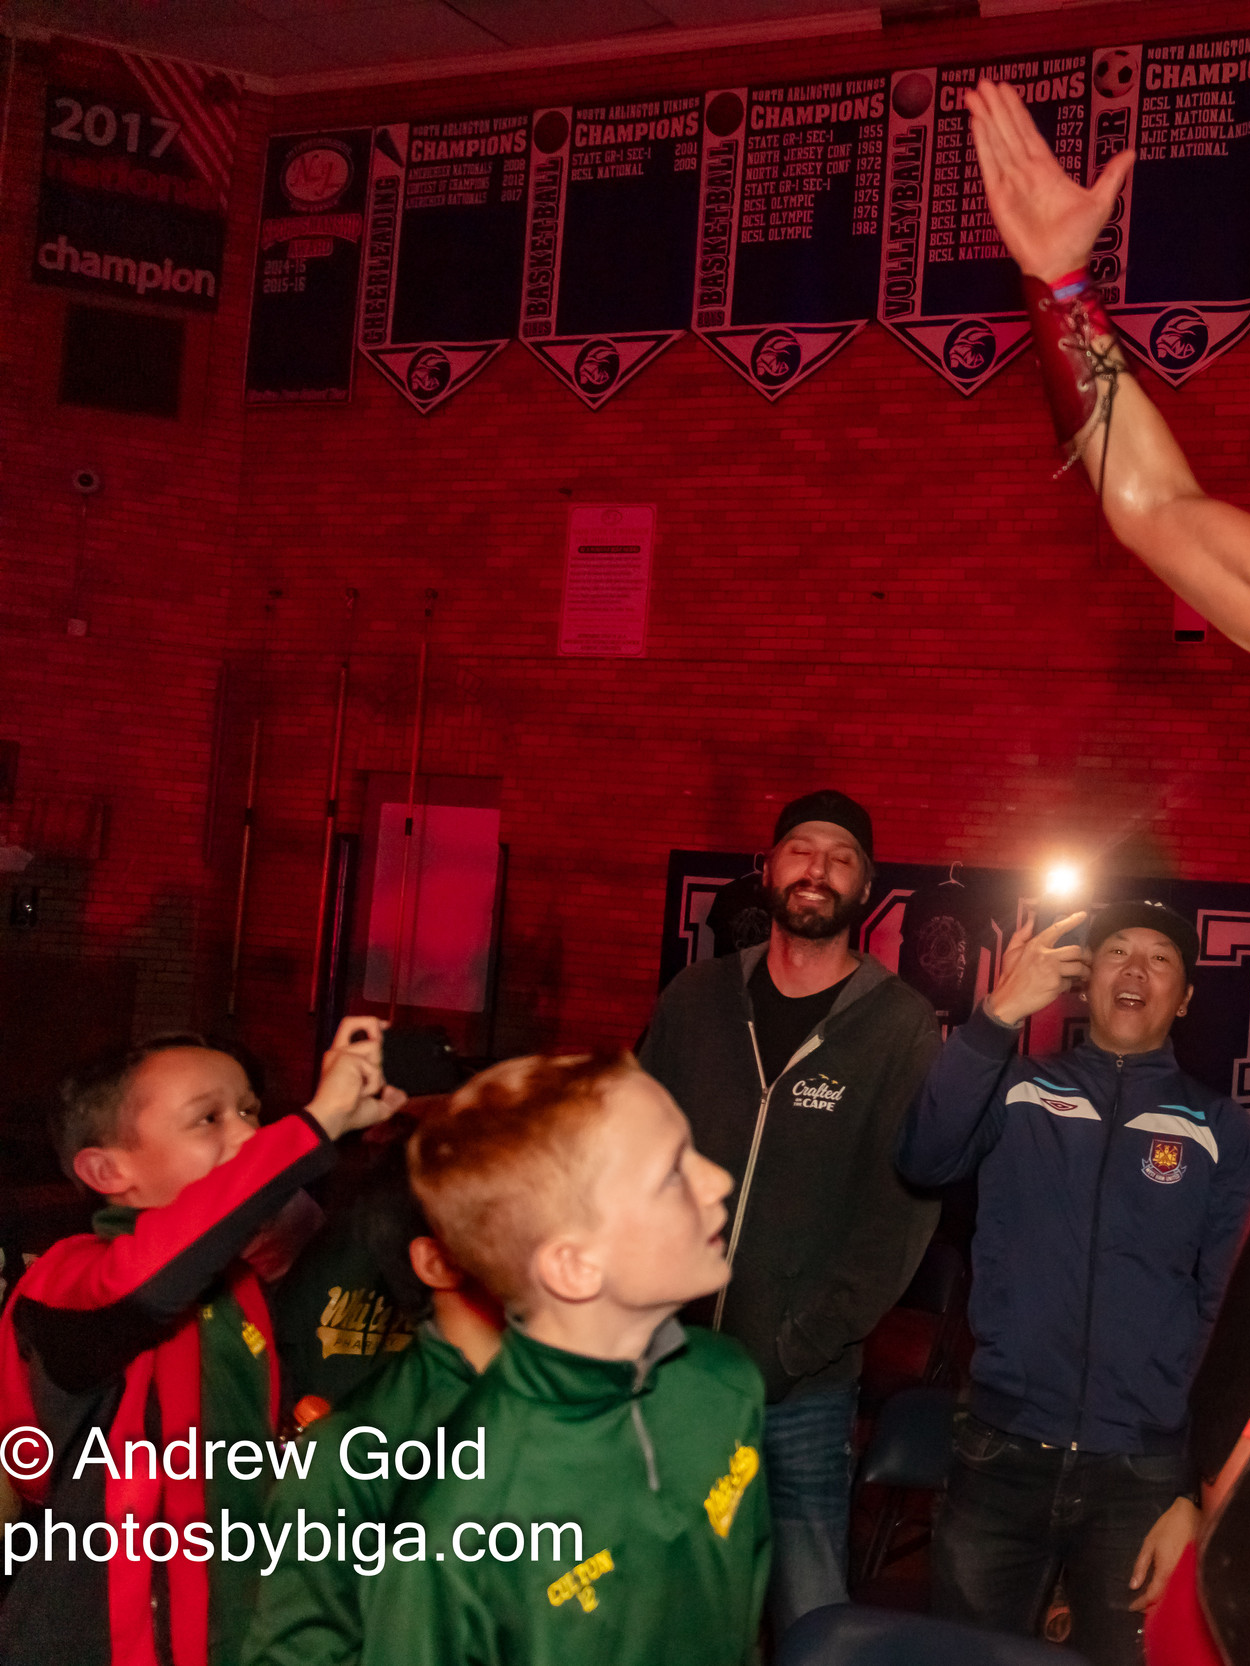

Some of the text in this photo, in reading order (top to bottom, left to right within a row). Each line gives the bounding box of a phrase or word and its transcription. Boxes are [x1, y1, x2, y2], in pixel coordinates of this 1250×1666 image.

[1148, 45, 1183, 60] NORTH
[942, 57, 1086, 83] NORTH ARLINGTON VIKINGS
[752, 78, 885, 101] NORTH ARLINGTON VIKINGS
[1143, 96, 1170, 111] BCSL
[1175, 91, 1235, 109] NATIONAL
[576, 97, 699, 120] NORTH ARLINGTON VIKINGS
[751, 93, 884, 130] CHAMPIONS
[1057, 105, 1083, 119] 1976
[1142, 112, 1169, 128] BCSL
[1174, 108, 1234, 125] NATIONAL
[51, 98, 182, 158] 2017
[575, 111, 699, 147] CHAMPIONS
[748, 124, 883, 149] STATE GR-1 SEC-1 1955
[1056, 122, 1083, 136] 1977
[1141, 129, 1168, 144] NJIC
[411, 129, 527, 162] CHAMPIONS
[572, 142, 698, 167] STATE GR-1 SEC-1 2001
[1055, 139, 1082, 153] 1979
[1140, 146, 1166, 160] NJIC
[1170, 142, 1229, 157] NATIONAL
[571, 158, 696, 181] BCSL NATIONAL 2009
[746, 157, 881, 181] NORTH JERSEY CONF 1972
[744, 173, 880, 197] STATE GR-1 SEC-1 1972
[744, 189, 879, 212] BCSL OLYMPIC 1975
[698, 140, 738, 309] BASKETBALL
[741, 221, 877, 243] BCSL OLYMPIC 1982
[883, 126, 927, 320] VOLLEYBALL
[526, 156, 562, 318] BASKETBALL
[930, 232, 956, 246] BCSL
[38, 235, 216, 297] champion
[362, 175, 398, 345] CHEERLEADING
[928, 248, 954, 263] BCSL
[792, 1080, 846, 1101] Crafted
[802, 1098, 836, 1112] CAPE
